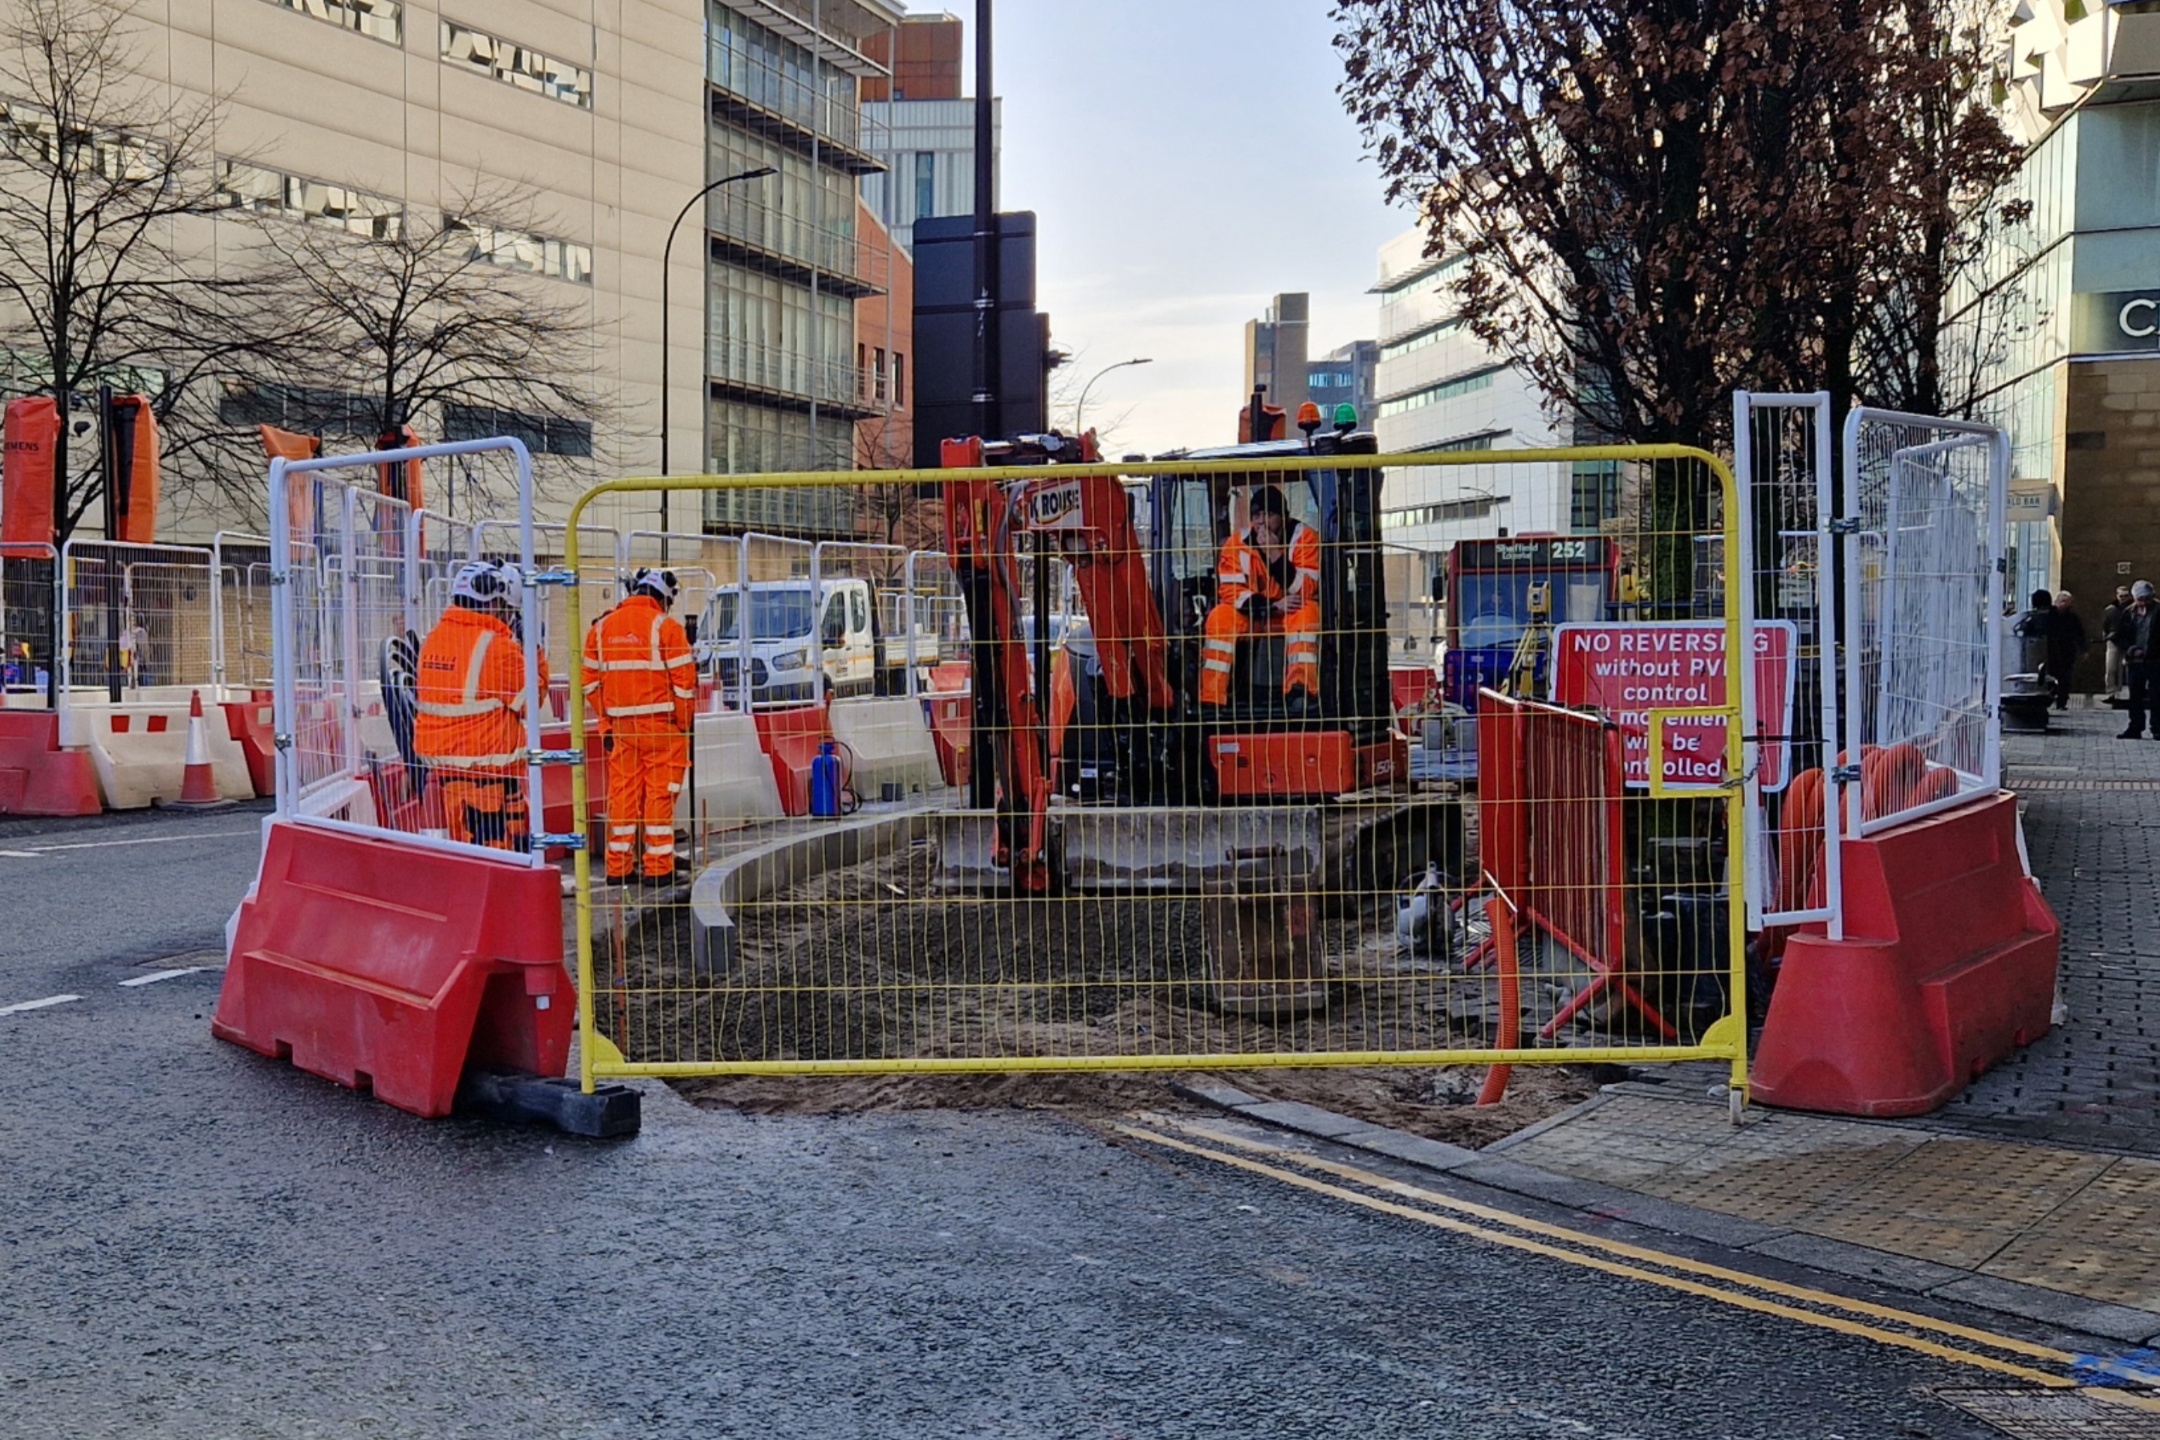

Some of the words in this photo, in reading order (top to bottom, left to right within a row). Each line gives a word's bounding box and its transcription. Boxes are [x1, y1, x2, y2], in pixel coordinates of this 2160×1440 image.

[1550, 541, 1587, 559] 252
[1574, 634, 1611, 652] NO
[1619, 633, 1769, 652] REVERSIG
[1595, 658, 1680, 677] without
[1623, 683, 1707, 701] control
[1672, 732, 1701, 751] be
